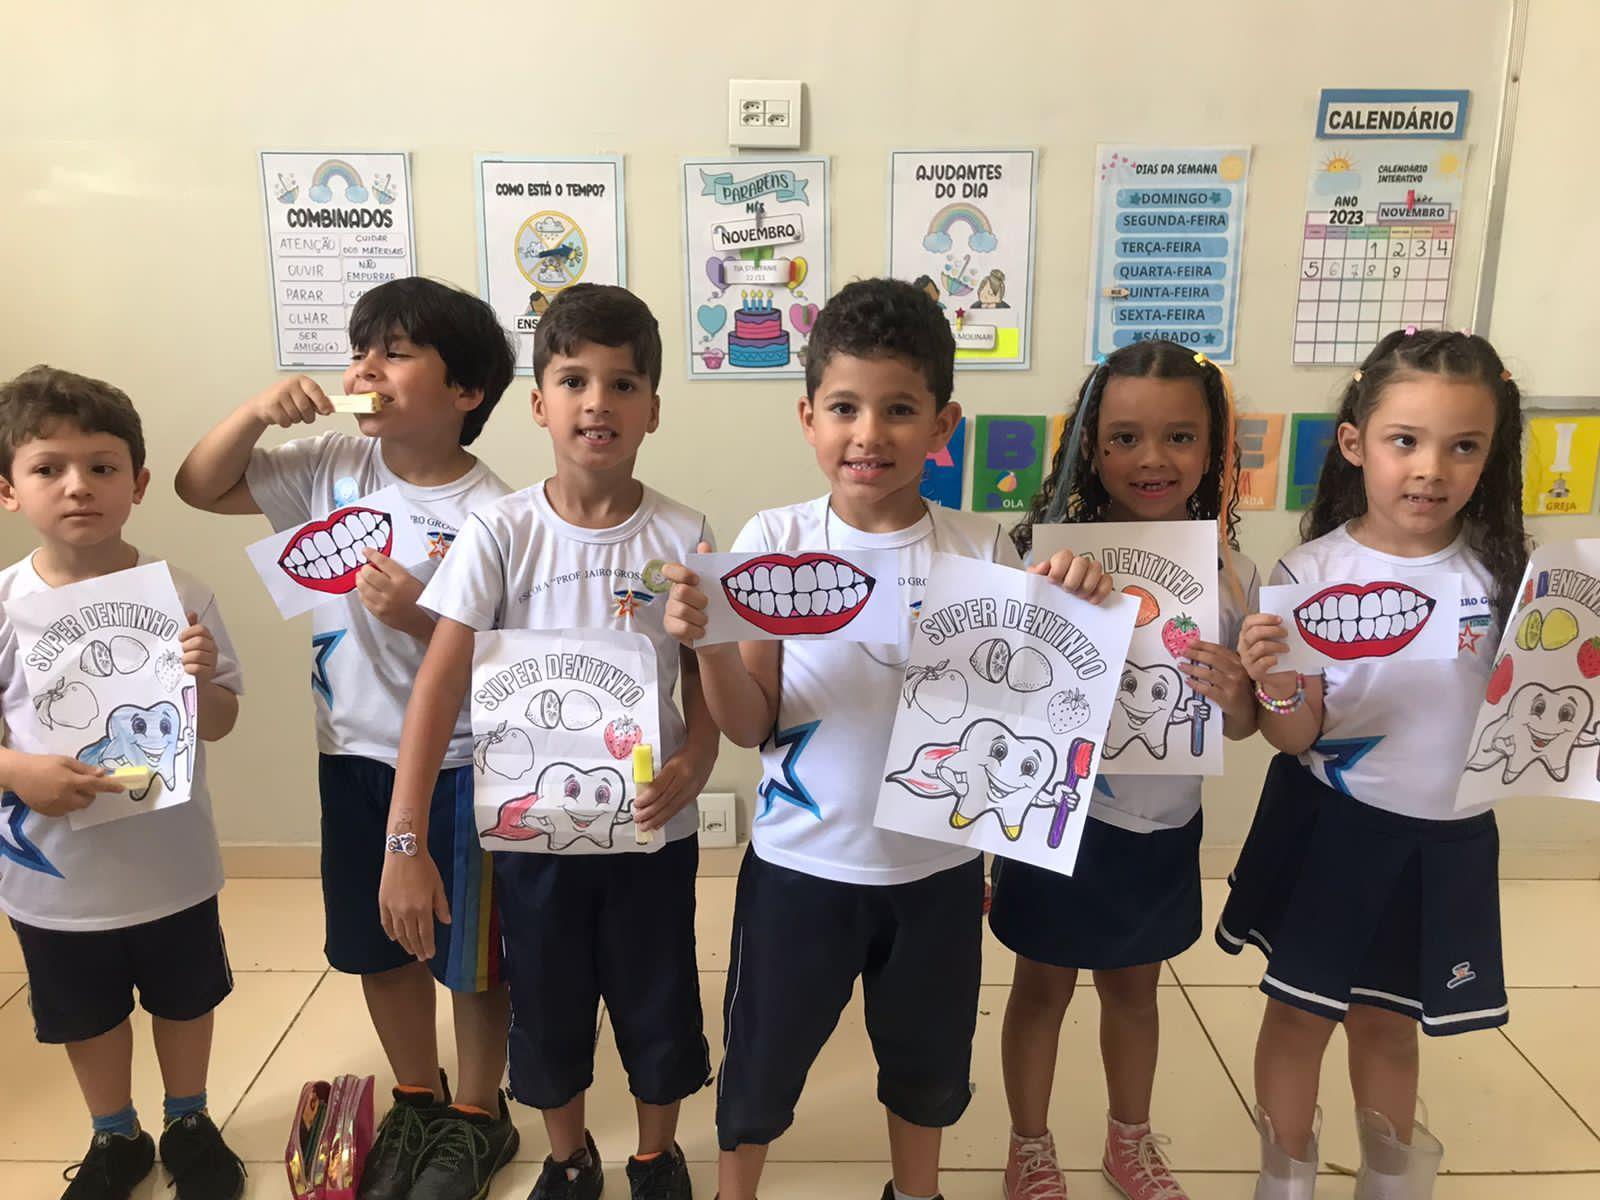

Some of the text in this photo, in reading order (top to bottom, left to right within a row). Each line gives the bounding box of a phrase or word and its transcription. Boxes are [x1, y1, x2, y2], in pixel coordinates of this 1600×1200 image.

[1329, 105, 1453, 130] CALENDÁRIO
[915, 164, 1003, 181] AJUDANTES
[1135, 164, 1218, 175] DIAS DA SEMANA
[1377, 164, 1428, 173] CALENDÁRIO
[1377, 174, 1423, 184] INTERATIVO
[496, 181, 605, 197] COMO ESTÁ O TEMPO?
[935, 183, 988, 199] DO DIA
[1141, 193, 1208, 205] DOMINGO
[1334, 196, 1358, 207] ANO
[287, 208, 393, 229] COMBINADOS
[1329, 210, 1364, 225] 2023
[1381, 207, 1445, 218] NOVEMBRO
[1123, 214, 1226, 227] SEGUNDA-FEIRA
[355, 234, 389, 243] CUIDAR
[721, 223, 796, 245] NOVEMBRO
[280, 236, 336, 254] ATENÇÃO
[1121, 241, 1201, 256] TERÇA-FEIRA
[1370, 240, 1448, 259] 1 2 3 4
[288, 264, 324, 277] OUVIR
[346, 271, 396, 281] EMPURRAR
[1119, 265, 1213, 280] QUARTA-FEIRA
[1304, 261, 1319, 278] 5
[1329, 262, 1340, 277] 6
[1366, 264, 1376, 277] 8
[1392, 265, 1401, 278] 9
[286, 288, 323, 302] PARAR
[1126, 287, 1210, 299] UINTA-FEIRA
[289, 312, 329, 325] OLHAR
[1119, 309, 1206, 321] SEXTA-FEIRA
[299, 332, 318, 340] SER
[1143, 328, 1201, 343] SÁBADO
[986, 420, 1037, 470] B
[1549, 424, 1577, 472] I
[584, 568, 612, 579] JAIRO
[1102, 548, 1204, 604] DENTINHO
[25, 602, 179, 672] SUPER DENTINHO
[920, 598, 1108, 681] SUPER DENTINHO
[474, 653, 645, 711] SUPER DENTINHO
